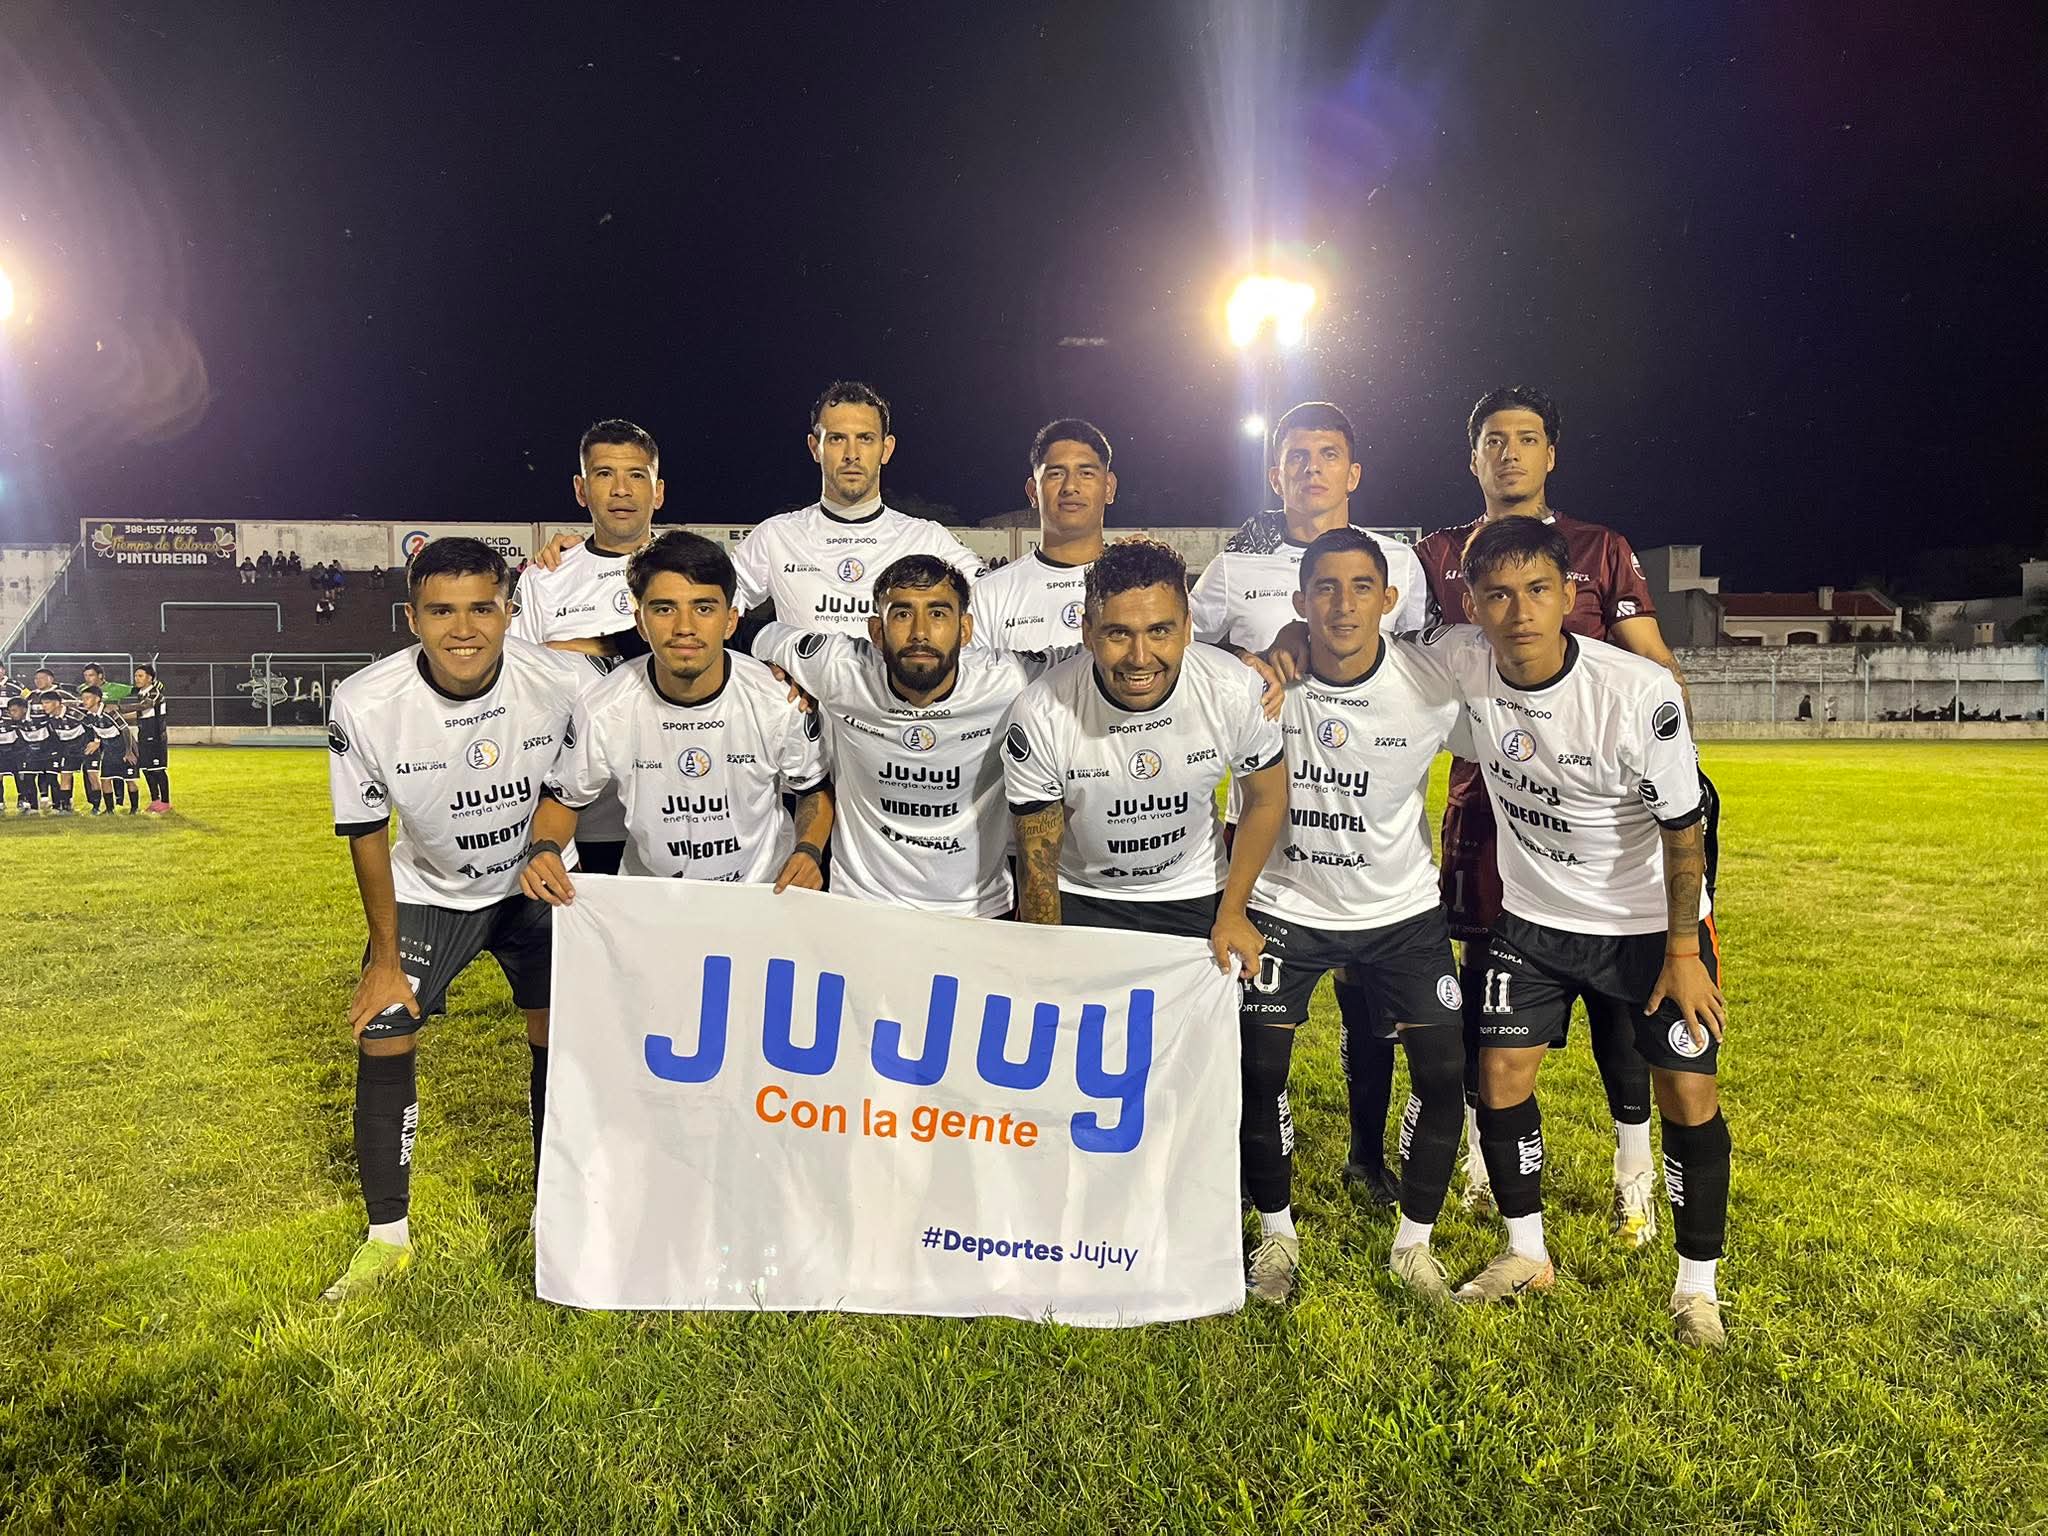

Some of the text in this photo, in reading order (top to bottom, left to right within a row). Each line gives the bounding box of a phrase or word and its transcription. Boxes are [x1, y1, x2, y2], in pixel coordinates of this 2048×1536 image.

[855, 537, 877, 545] 2000
[117, 552, 208, 565] PINTURERIA
[1046, 581, 1076, 590] SPORT
[1306, 691, 1369, 708] SPORT 2000
[445, 707, 506, 728] SPORT 2000
[921, 709, 951, 718] 2000
[1524, 707, 1552, 720] 2000
[662, 720, 725, 731] SPORT 2000
[1109, 717, 1172, 735] SPORT 2000
[523, 739, 553, 751] ZAPLA
[1374, 740, 1408, 748] ZAPLA
[1187, 752, 1217, 764] ZAPLA
[1557, 757, 1594, 767] ZAPLA
[1330, 785, 1350, 797] viva
[495, 800, 518, 811] viva
[879, 797, 960, 818] VIDEOTEL
[701, 814, 724, 823] viva
[1150, 812, 1172, 820] viva
[1290, 808, 1367, 833] VIDEOTEL
[1106, 826, 1187, 854] VIDEOTEL
[407, 952, 431, 967] ZAPLA
[1498, 951, 1523, 965] ZAPLA
[1483, 968, 1514, 1015] 11
[1261, 1003, 1288, 1013] 2000
[1498, 1026, 1530, 1035] 2000
[755, 1085, 1039, 1148] Con la gente
[1518, 1136, 1543, 1175] SPORT
[1663, 1163, 1685, 1207] SPORT
[921, 1226, 1139, 1272] #Deportes Jujuy
